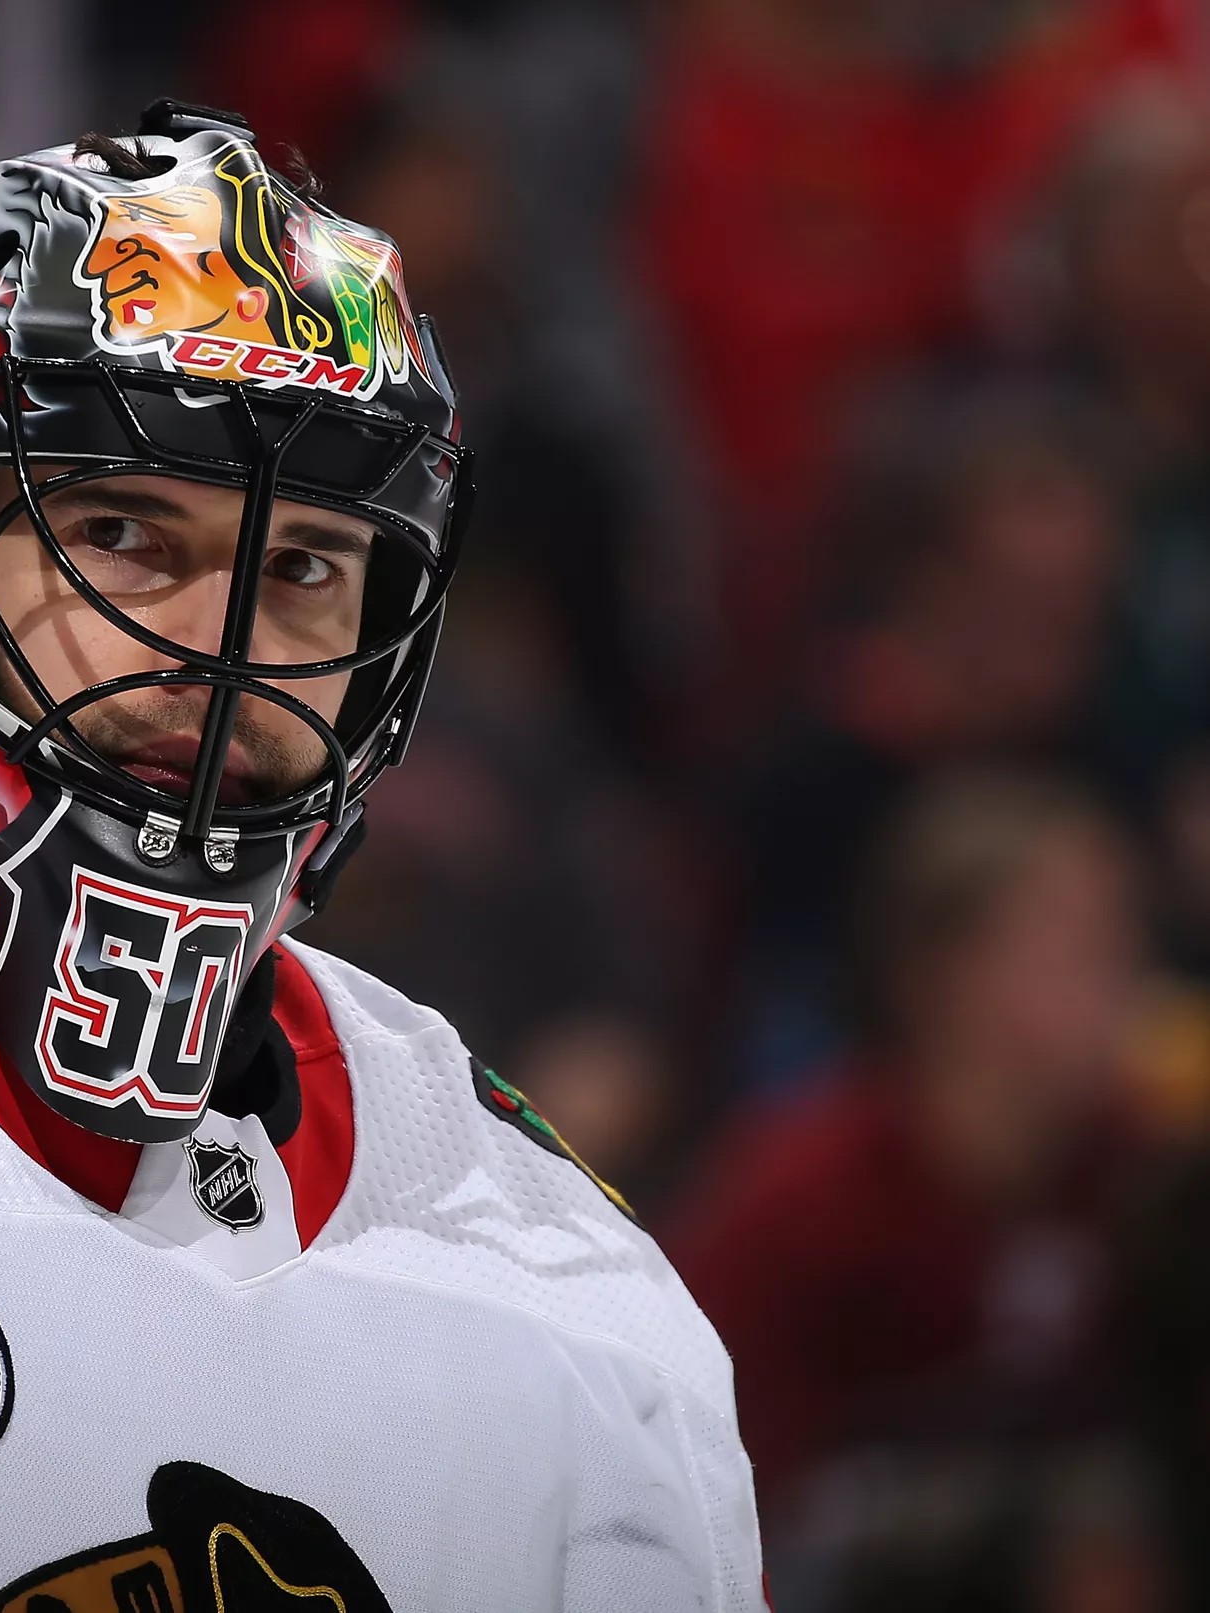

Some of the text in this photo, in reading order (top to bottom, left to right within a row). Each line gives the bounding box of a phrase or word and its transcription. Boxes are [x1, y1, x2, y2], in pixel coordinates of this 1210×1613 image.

[169, 333, 368, 395] CCM
[34, 864, 254, 1119] 50
[208, 1164, 246, 1207] NHL
